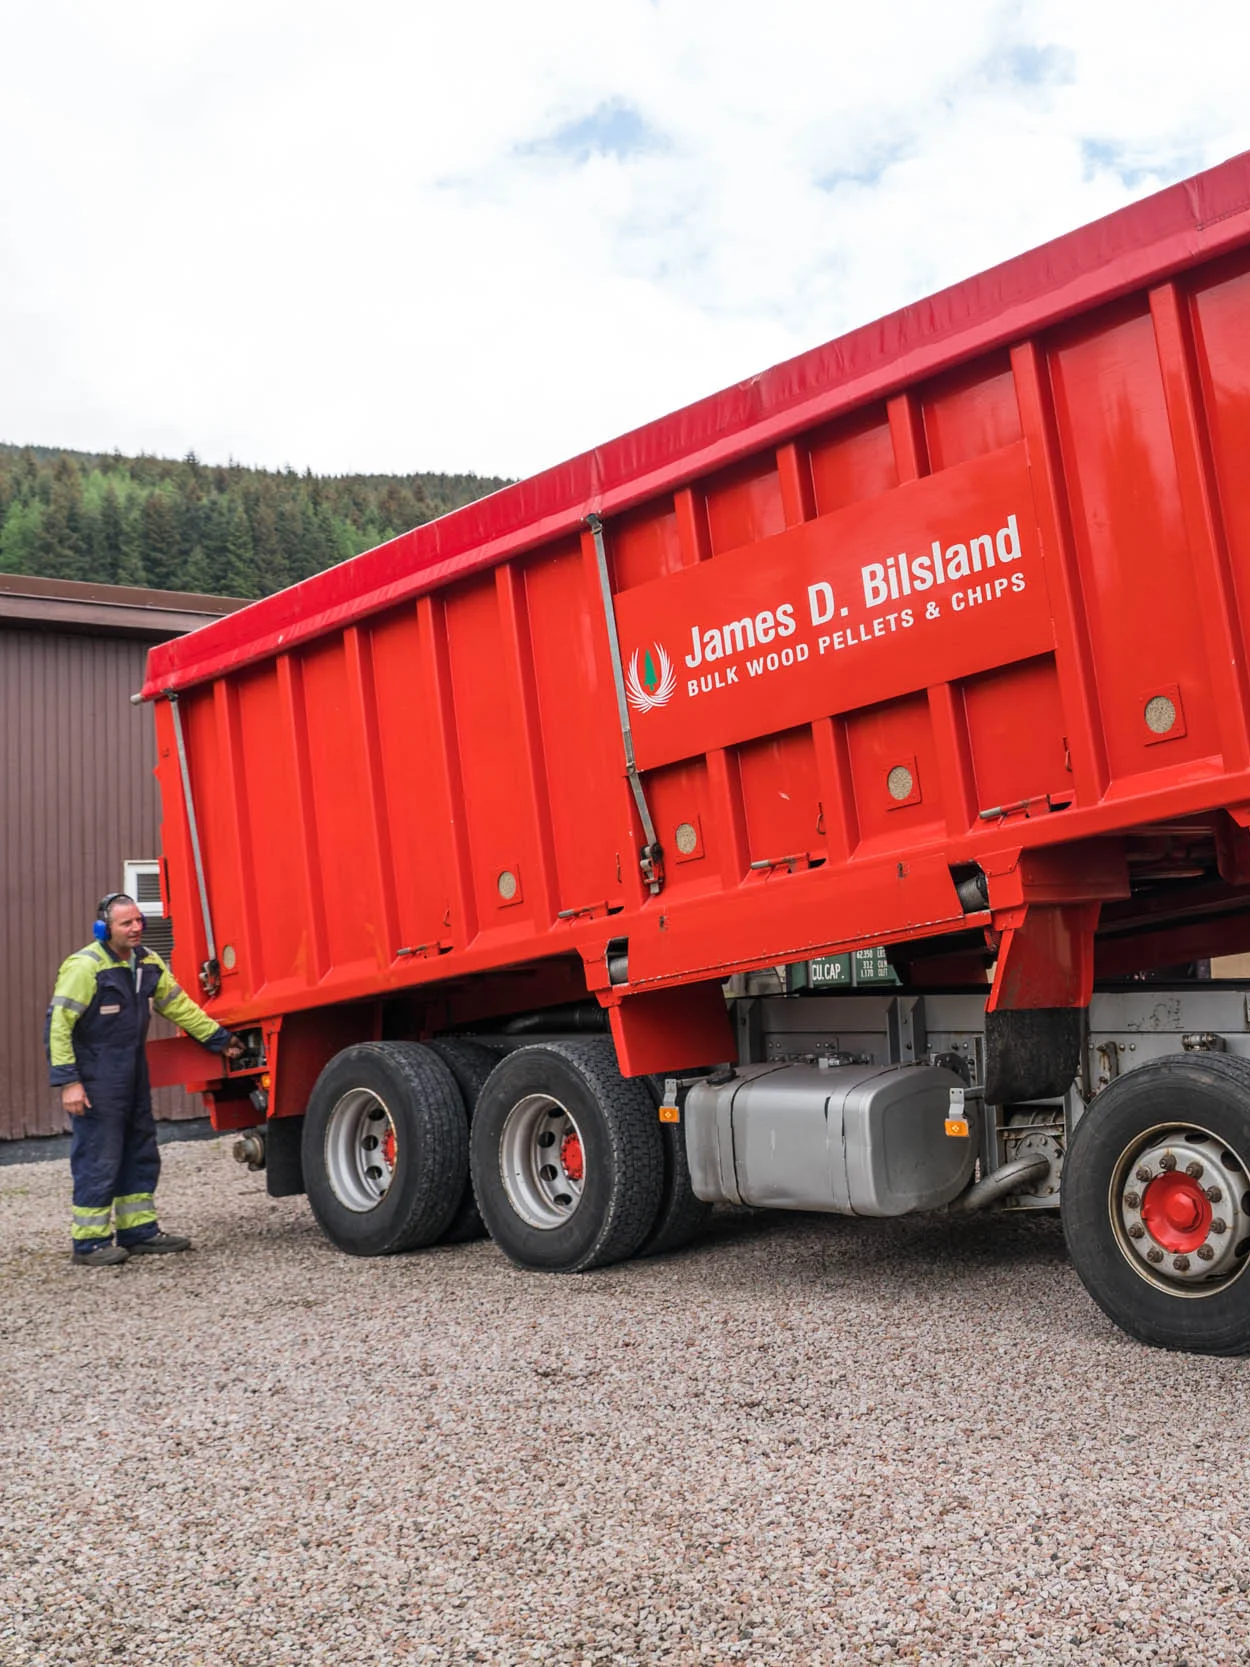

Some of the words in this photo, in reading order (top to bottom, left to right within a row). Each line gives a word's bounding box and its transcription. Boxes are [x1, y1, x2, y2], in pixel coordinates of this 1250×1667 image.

[684, 603, 797, 668] James
[808, 581, 849, 626] D.
[860, 514, 1022, 608] Bilsland
[687, 666, 739, 697] BULK
[746, 644, 809, 678] WOOD
[818, 609, 915, 655] PELLETS
[925, 601, 941, 620] &
[951, 572, 1026, 612] CHIPS
